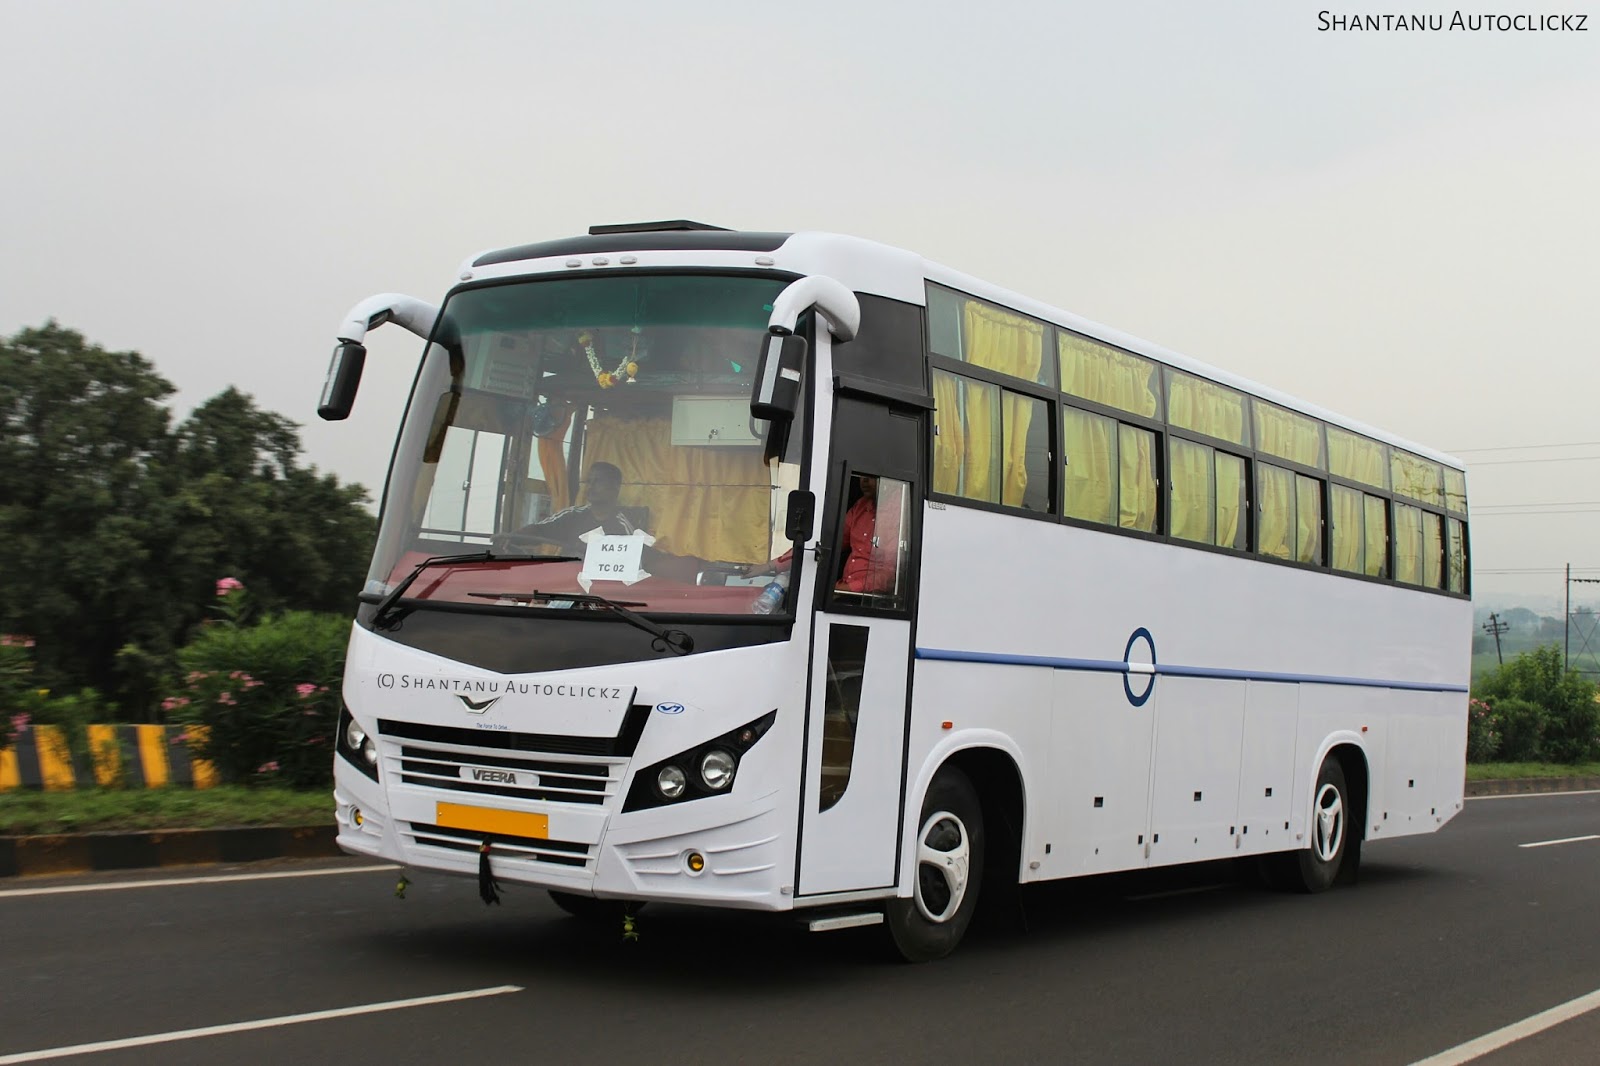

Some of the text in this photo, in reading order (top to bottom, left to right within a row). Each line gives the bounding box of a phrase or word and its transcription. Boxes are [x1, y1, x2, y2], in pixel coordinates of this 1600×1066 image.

[601, 543, 628, 552] KA 51
[598, 564, 625, 573] TC 02
[472, 769, 517, 784] VEERA
